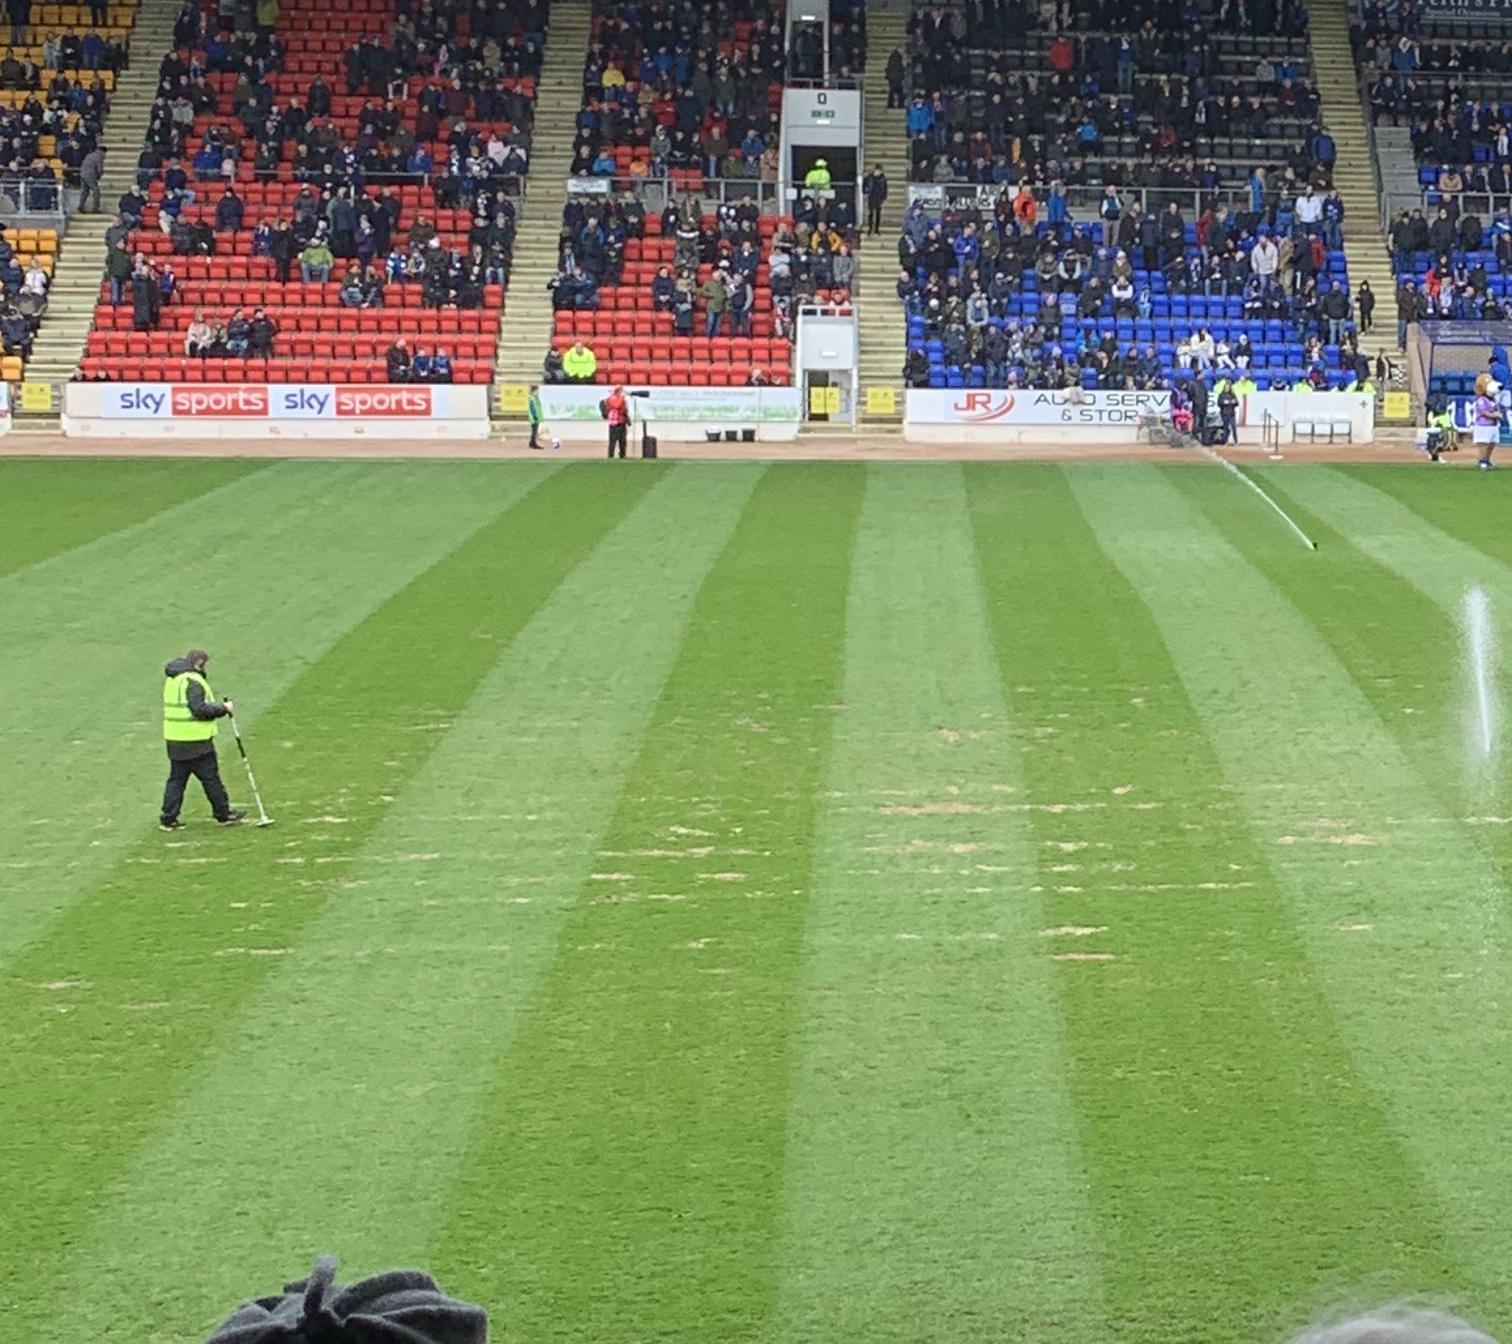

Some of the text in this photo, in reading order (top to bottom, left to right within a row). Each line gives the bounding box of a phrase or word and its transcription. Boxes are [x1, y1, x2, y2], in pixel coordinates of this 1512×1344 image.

[120, 387, 265, 415] sky sports
[284, 387, 428, 415] sky sports
[1034, 393, 1097, 406] AUO
[1061, 409, 1139, 422] & STOR
